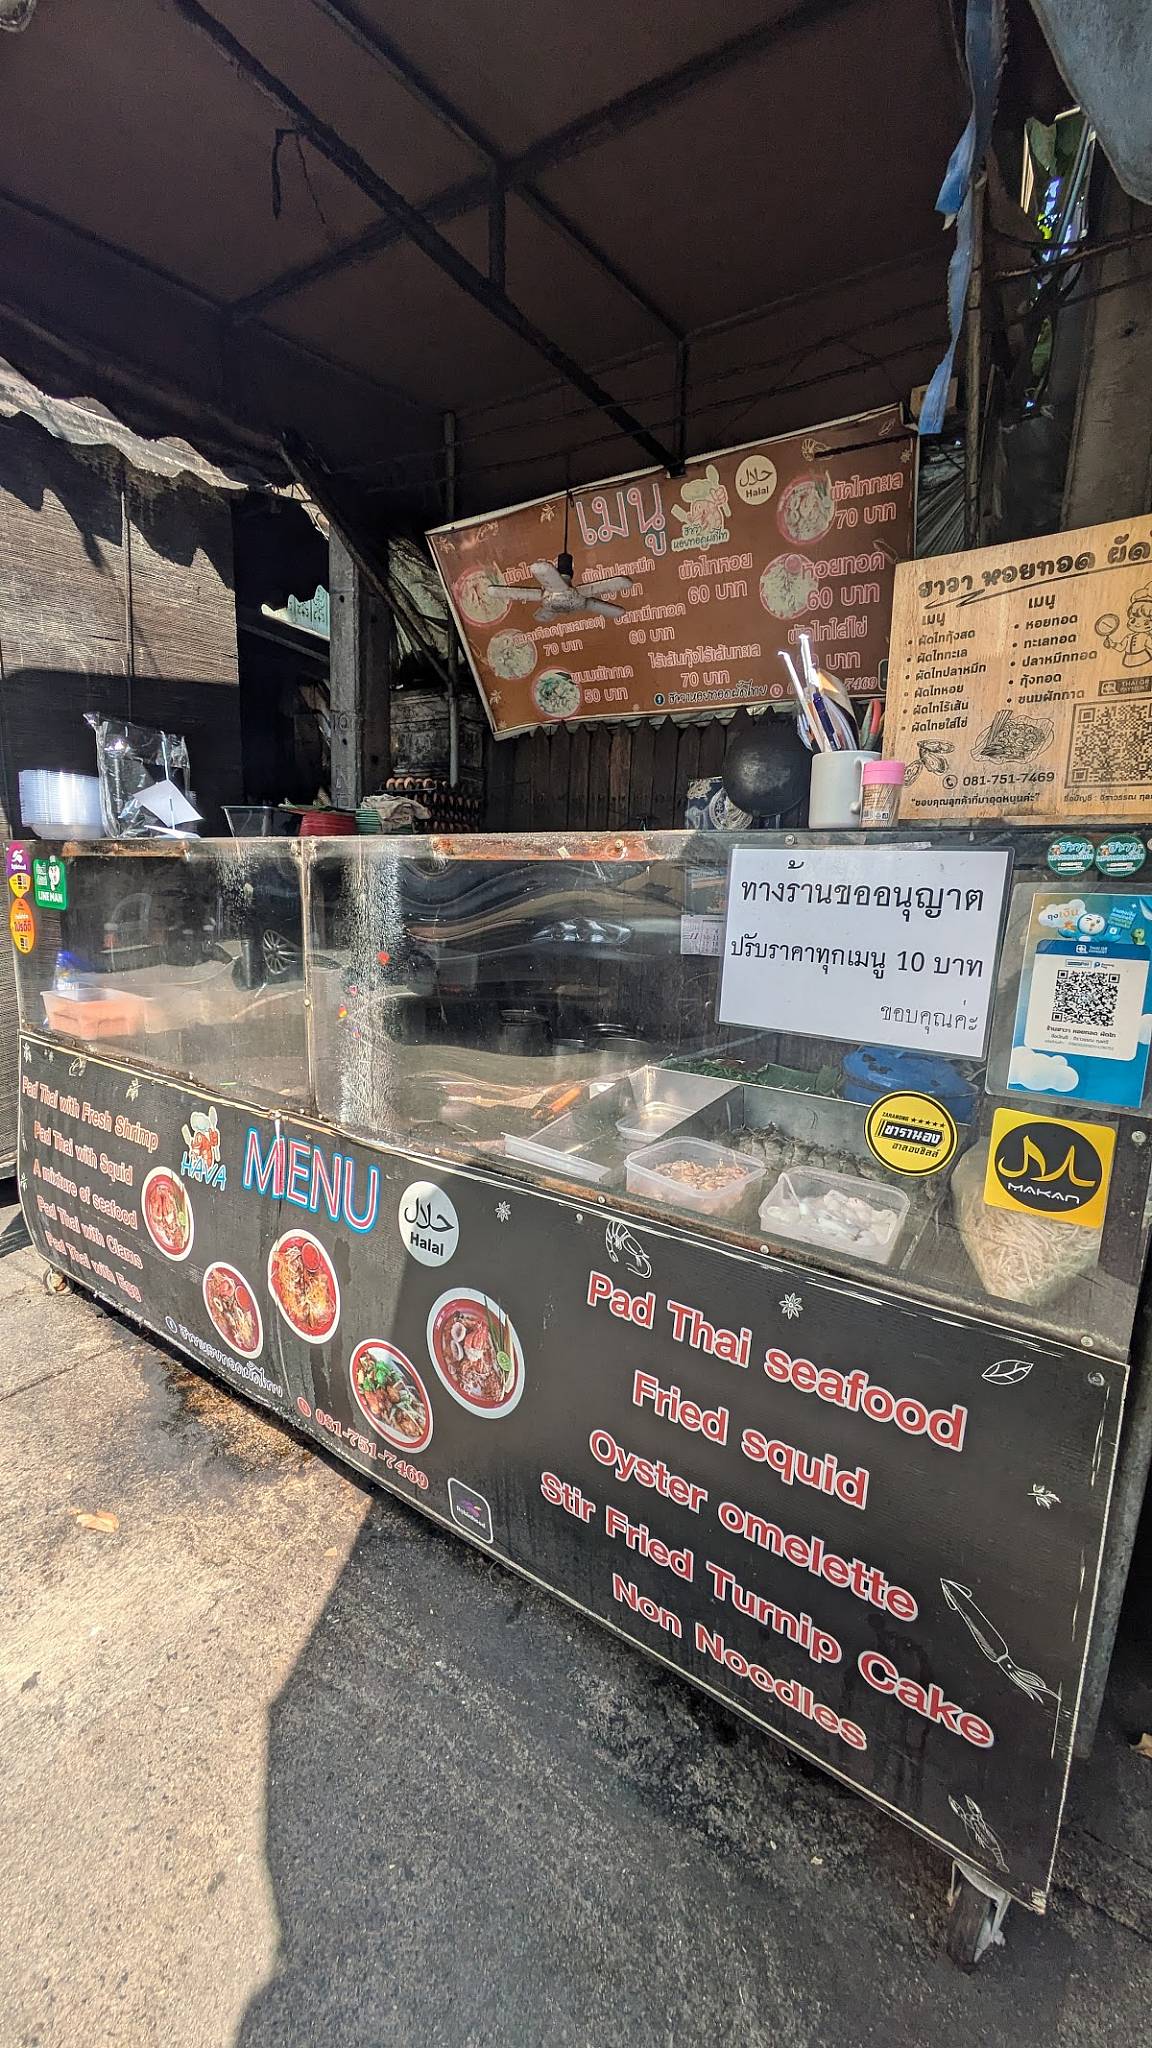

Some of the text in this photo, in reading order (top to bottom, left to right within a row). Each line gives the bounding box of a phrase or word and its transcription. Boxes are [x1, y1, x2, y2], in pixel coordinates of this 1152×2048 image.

[739, 467, 773, 487] حلال
[831, 472, 904, 501] ผัดไททะเล
[746, 485, 769, 498] Halal
[575, 483, 666, 556] เมนู
[835, 502, 896, 529] 70 บาท
[678, 552, 753, 580] ผัดไทหอย
[801, 551, 885, 579] หอยทอด
[981, 552, 1096, 588] หอยทอด
[687, 579, 748, 605] 60 บาท
[807, 582, 881, 611] 60 บาท
[1028, 594, 1056, 610] เมนู
[787, 615, 868, 645] ผัดไทใส่ไข่
[921, 612, 946, 627] เมนู
[1025, 614, 1078, 630] หอยทอด
[543, 638, 584, 657] 70 บาท
[629, 626, 675, 645] 60 บาท
[918, 629, 976, 646] ผัดไทกุ้งสด
[1023, 633, 1077, 649] ทะเลทอด
[826, 651, 861, 671] บาท
[917, 648, 968, 664] ผัดไททะเล
[1022, 650, 1098, 667] ปลาหมึกทอด
[681, 670, 730, 688] 70 บาท
[915, 662, 987, 681] ผัดไทปลาหมึก
[1020, 673, 1062, 689] กุ้งทอด
[584, 686, 629, 704] 50 บาท
[914, 684, 964, 698] ผัดไทหอย
[1018, 689, 1085, 705] ขนมผักกาด
[912, 700, 969, 716] ผัดไทไร้เส้น
[962, 771, 1055, 787] 081-751-7469
[740, 860, 985, 922] ทางร้านขออนุญาต
[730, 935, 886, 980] ปรับราคาทุกเมนู
[896, 949, 926, 973] 10
[933, 953, 983, 978] บาท
[880, 999, 979, 1034] ขอบคุณค่ะ
[22, 1075, 159, 1153] Pad Thai with Fresh Shrimp
[33, 1120, 134, 1186] Pad Thai with Squid
[180, 1155, 227, 1191] HAVA
[242, 1126, 382, 1234] MENU
[33, 1158, 138, 1231] A mixture of seafood
[1007, 1182, 1080, 1205] MAKAN
[404, 1199, 454, 1233] حلال
[37, 1194, 143, 1270] Pad Thai with Clams
[409, 1231, 444, 1257] Halal
[45, 1230, 143, 1303] Pad Thai with Egg
[587, 1272, 968, 1453] Pad Thai seafood
[315, 1407, 429, 1490] 081-751-7469
[632, 1369, 870, 1510] Fried squid
[588, 1429, 919, 1623] Oyster omelette
[540, 1471, 995, 1749] Stir Fried Turnip Cake
[611, 1573, 868, 1752] Non Noodles
